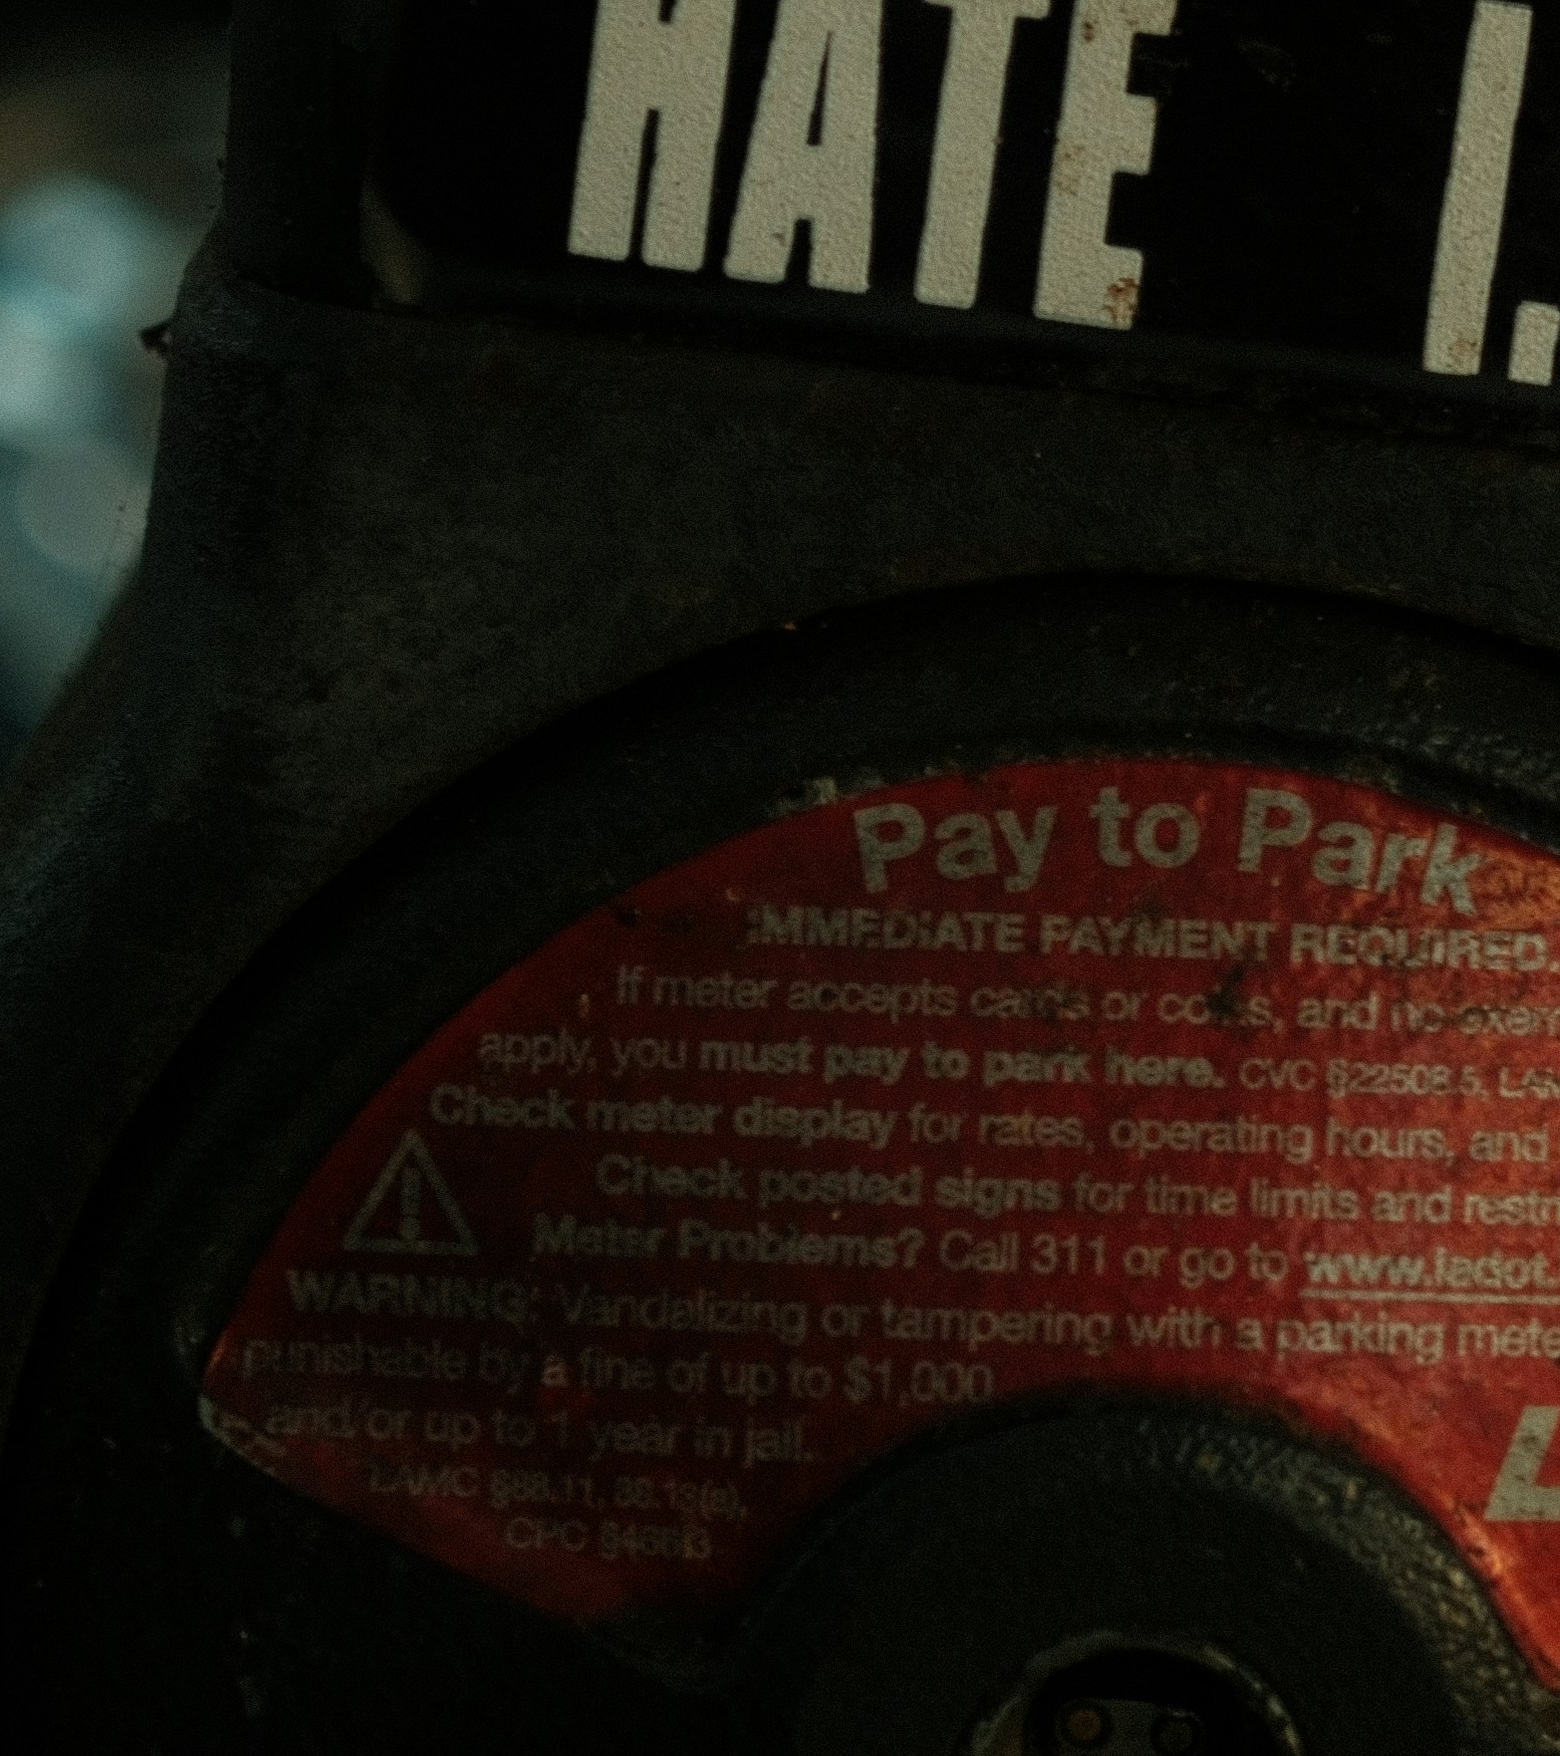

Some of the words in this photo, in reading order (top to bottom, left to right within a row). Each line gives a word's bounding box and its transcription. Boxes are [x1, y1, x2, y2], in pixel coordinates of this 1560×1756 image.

[852, 799, 1057, 894] Pay
[1089, 786, 1201, 869] to
[1238, 787, 1485, 917] Park
[746, 903, 1027, 953] IMMEDIATE
[1039, 913, 1278, 964] PAYMENT
[616, 963, 648, 1006] If
[653, 966, 779, 1010] meter
[787, 974, 959, 1024] accepts
[1103, 989, 1149, 1022] or
[1157, 985, 1285, 1033] cos,
[1296, 991, 1380, 1031] and
[476, 1026, 598, 1076] apply,
[608, 1036, 688, 1079] you
[699, 1036, 816, 1074] must
[823, 1043, 911, 1086] pay
[922, 1040, 971, 1080] to
[981, 1043, 1091, 1089] park
[1103, 1047, 1226, 1088] here.
[1240, 1057, 1318, 1092] CVC
[430, 1082, 576, 1132] Check
[586, 1094, 725, 1136] meter
[733, 1096, 899, 1150] display
[908, 1101, 964, 1144] for
[977, 1110, 1096, 1154] rates,
[1108, 1111, 1315, 1167] operating
[1324, 1117, 1455, 1167] hours,
[1468, 1125, 1550, 1164] and
[595, 1153, 748, 1200] Check
[758, 1162, 925, 1210] posted
[934, 1166, 1064, 1220] signs
[1071, 1170, 1134, 1215] for
[1144, 1173, 1238, 1218] time
[1249, 1175, 1360, 1223] limits
[1369, 1184, 1453, 1225] and
[532, 1210, 670, 1259] Meter
[677, 1217, 926, 1271] Problems?
[938, 1228, 1020, 1275] Call
[1030, 1231, 1107, 1277] 311
[1123, 1243, 1170, 1278] or
[1178, 1244, 1237, 1289] go
[1247, 1241, 1290, 1282] to
[285, 1268, 541, 1325] WARNING:
[555, 1283, 809, 1343] Vandalizing
[820, 1304, 870, 1339] or
[880, 1297, 1116, 1357] tampering
[1125, 1305, 1224, 1350] with
[1233, 1318, 1266, 1352] a
[1276, 1312, 1445, 1365] parking
[240, 1332, 469, 1382] punishable
[478, 1344, 533, 1395] by
[541, 1351, 568, 1387] a
[577, 1347, 656, 1392] fine
[665, 1350, 712, 1394] of
[722, 1359, 780, 1404] up
[788, 1357, 832, 1400] to
[842, 1356, 996, 1409] $1,000
[424, 1409, 481, 1453] up
[493, 1407, 539, 1448] to
[551, 1409, 571, 1449] 1
[590, 1416, 681, 1463] year
[692, 1416, 737, 1457] in
[742, 1415, 815, 1469] jail.
